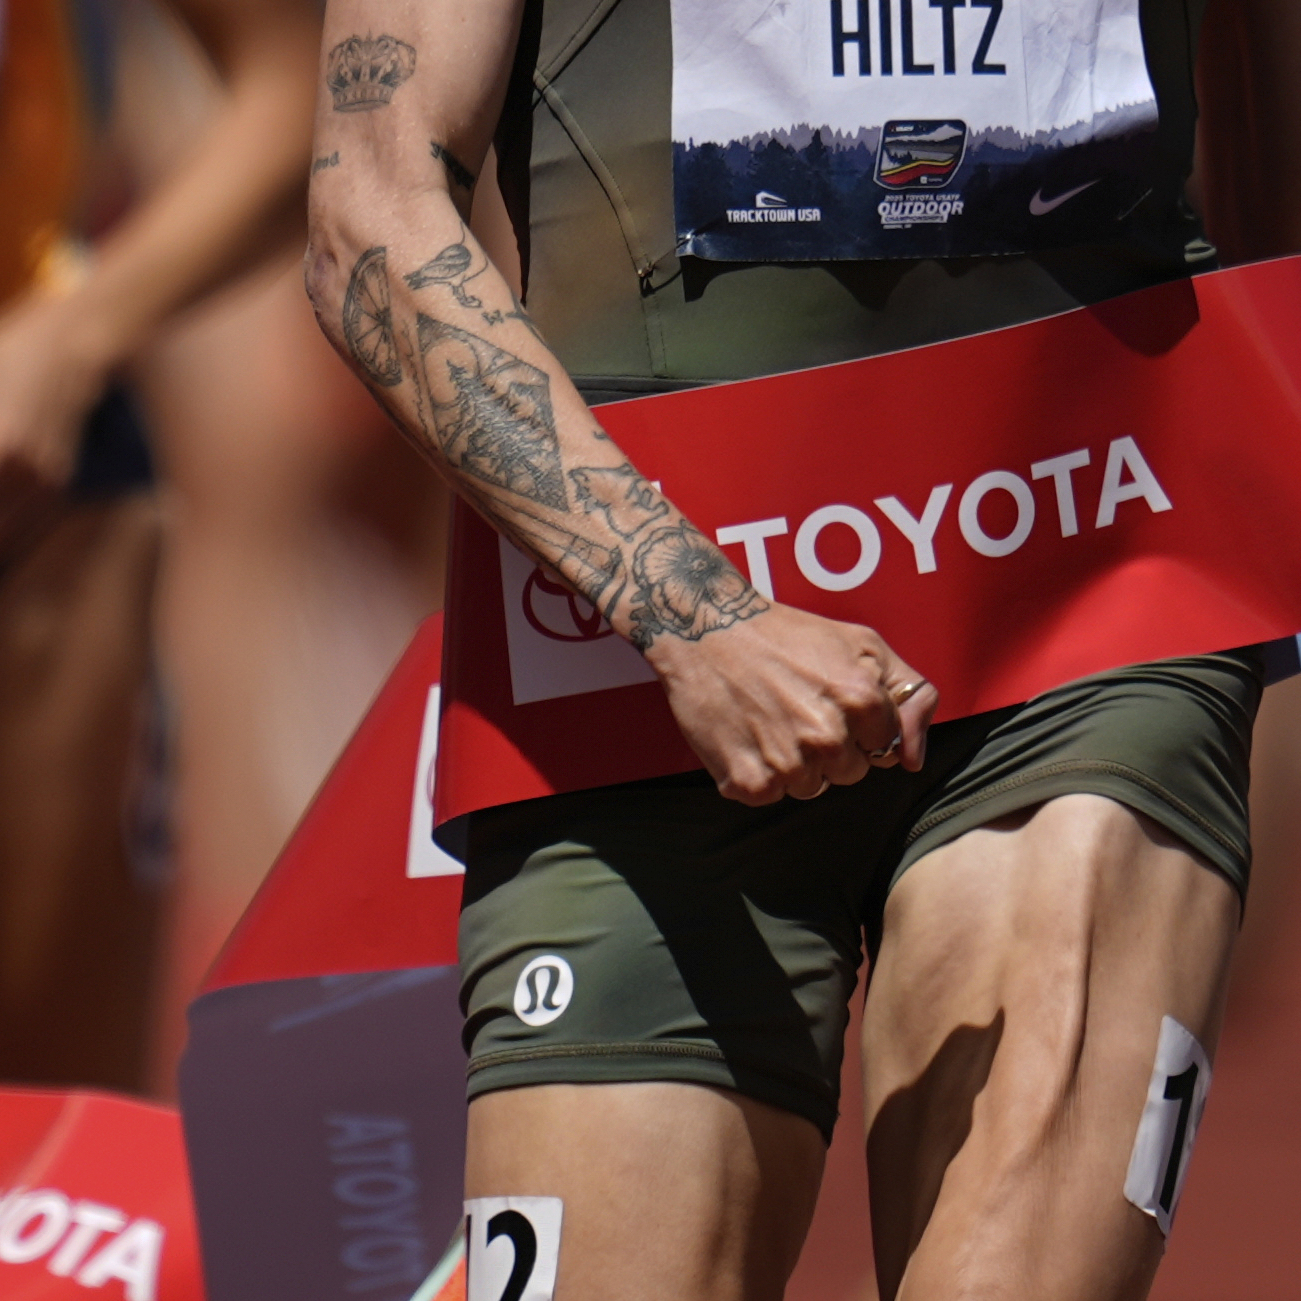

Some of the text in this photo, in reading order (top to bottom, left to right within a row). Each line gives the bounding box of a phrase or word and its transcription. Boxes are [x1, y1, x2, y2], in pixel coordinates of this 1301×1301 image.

[726, 207, 821, 223] TRACKTOWN USA
[877, 200, 965, 217] OUTDOOR
[715, 435, 1173, 601] TOYOTA
